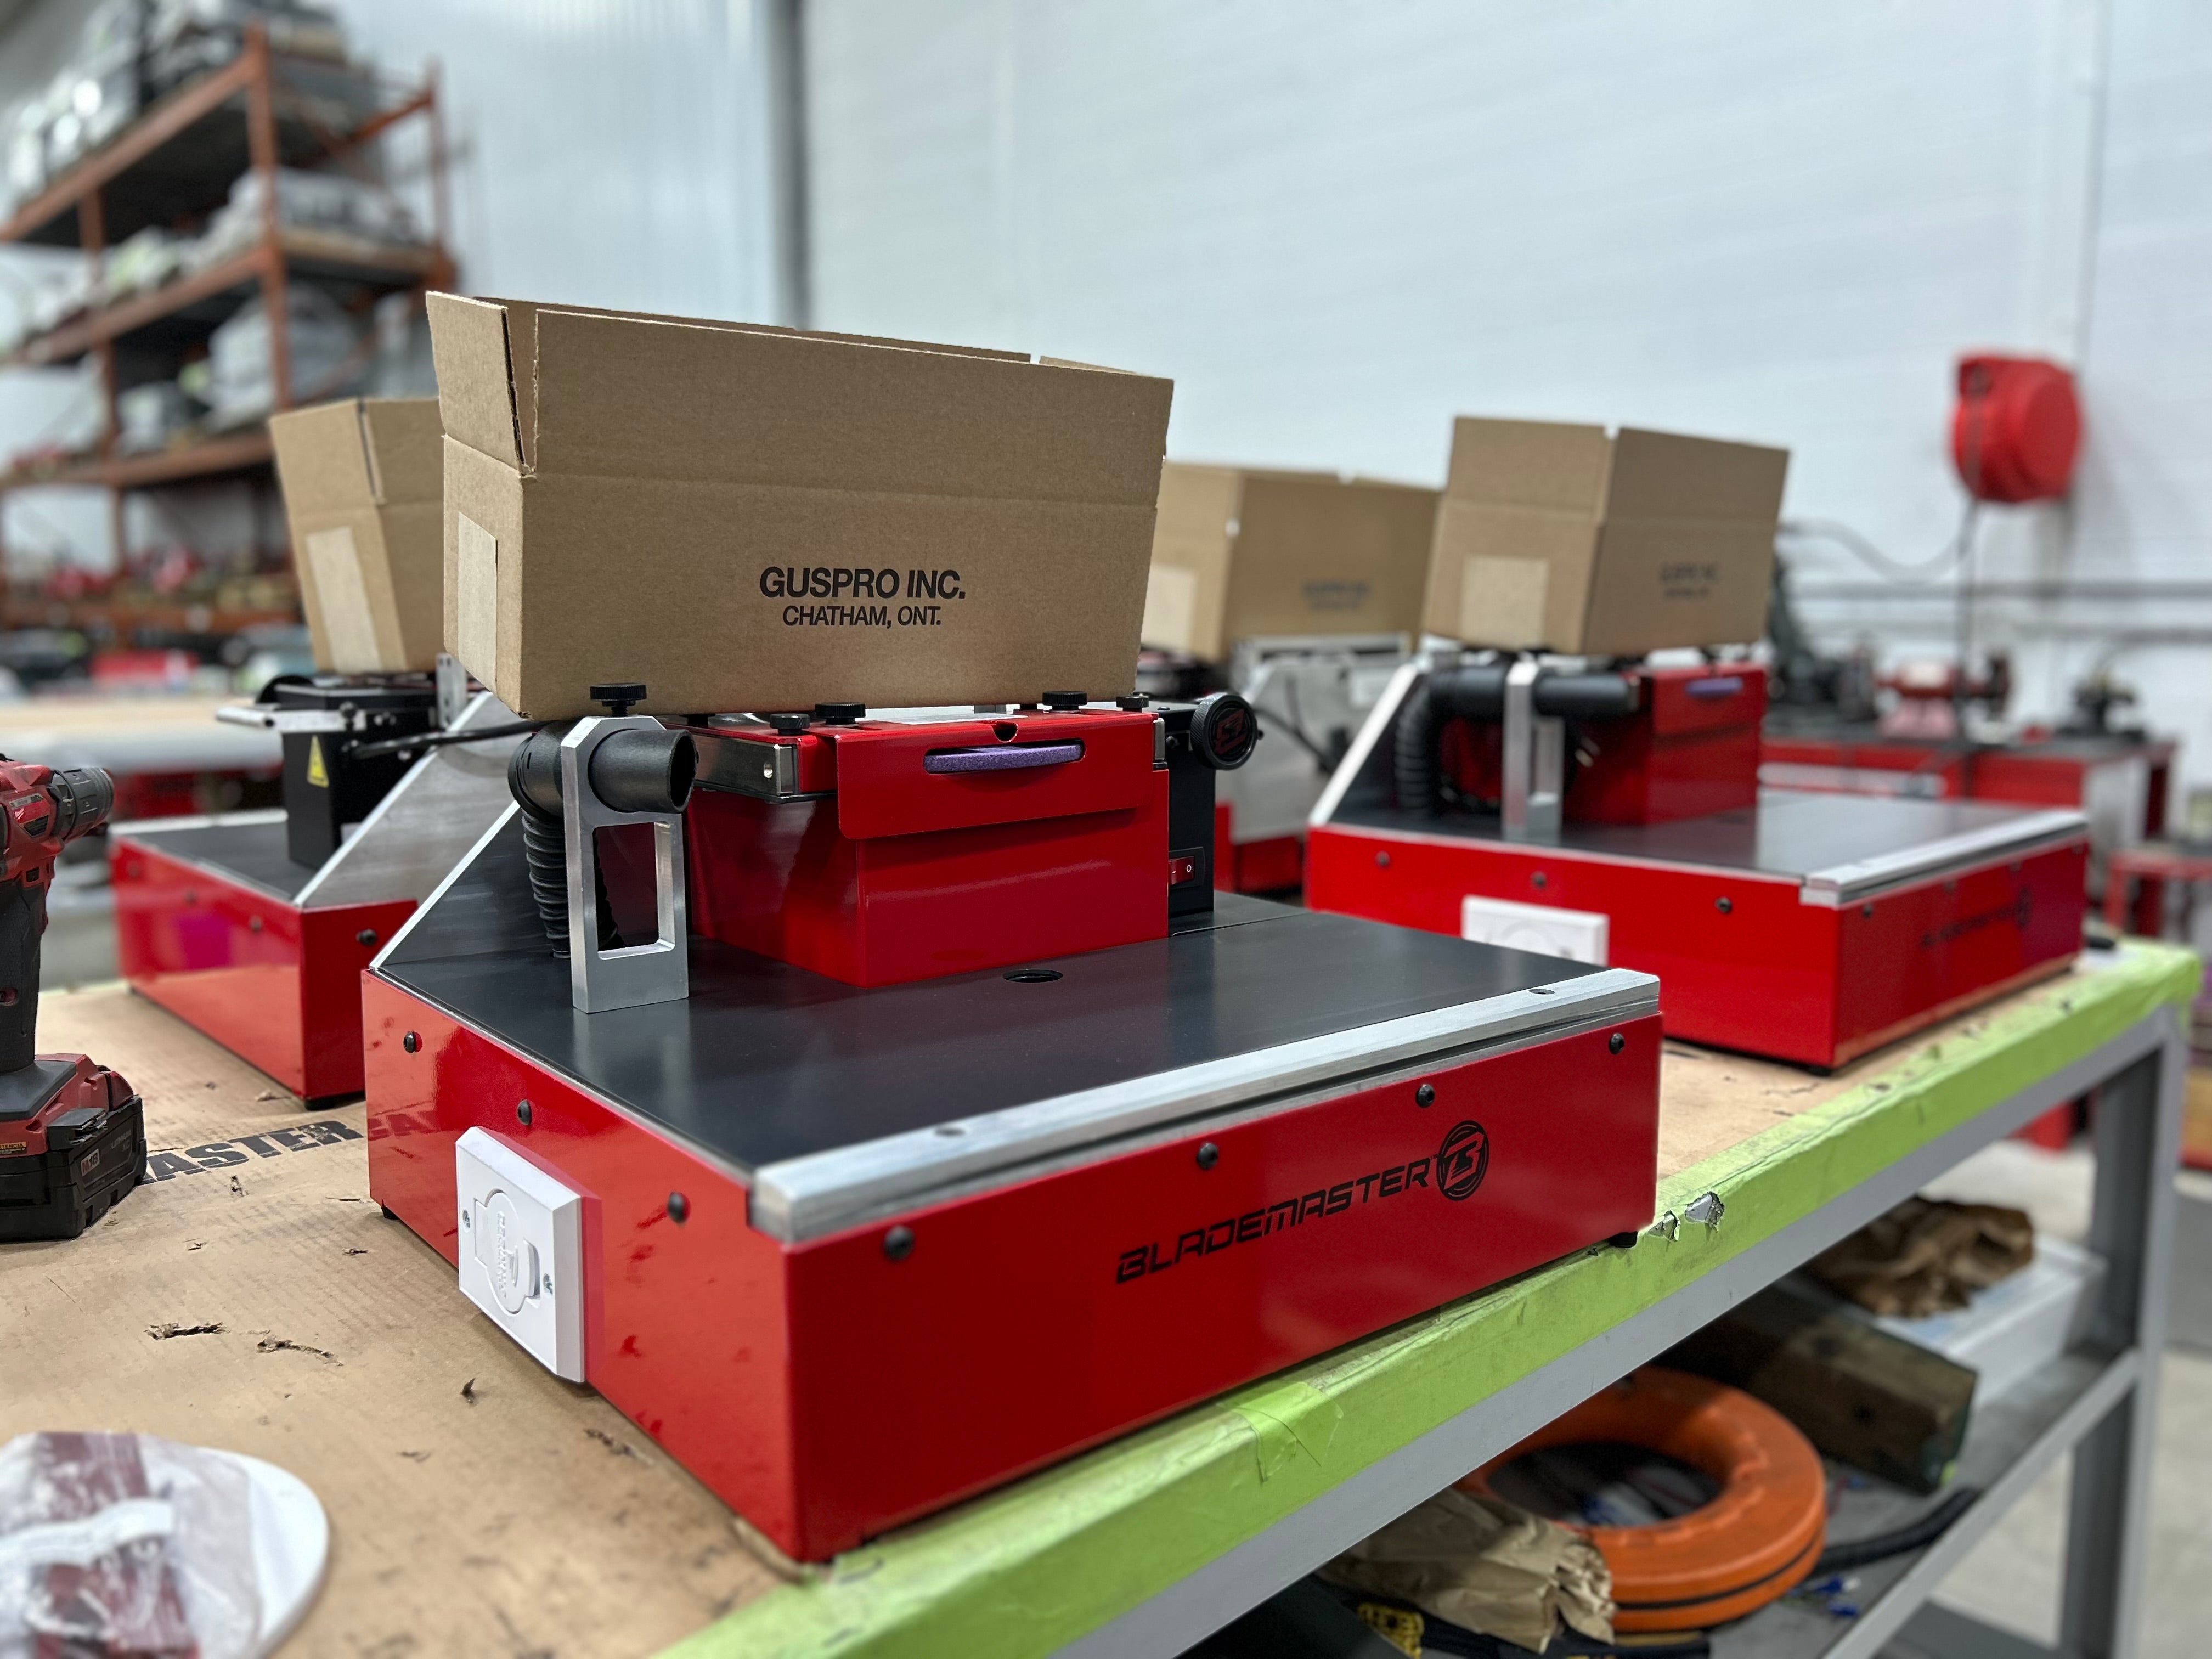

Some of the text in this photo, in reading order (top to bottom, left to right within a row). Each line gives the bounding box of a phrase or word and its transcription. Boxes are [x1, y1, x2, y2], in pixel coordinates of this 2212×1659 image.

[760, 566, 966, 599] GUSPRO INC.
[782, 606, 941, 629] CHATHAM, ONT.
[82, 1153, 99, 1173] M18
[140, 1120, 364, 1186] ASTER
[1116, 1156, 1430, 1284] BLADEMASTER
